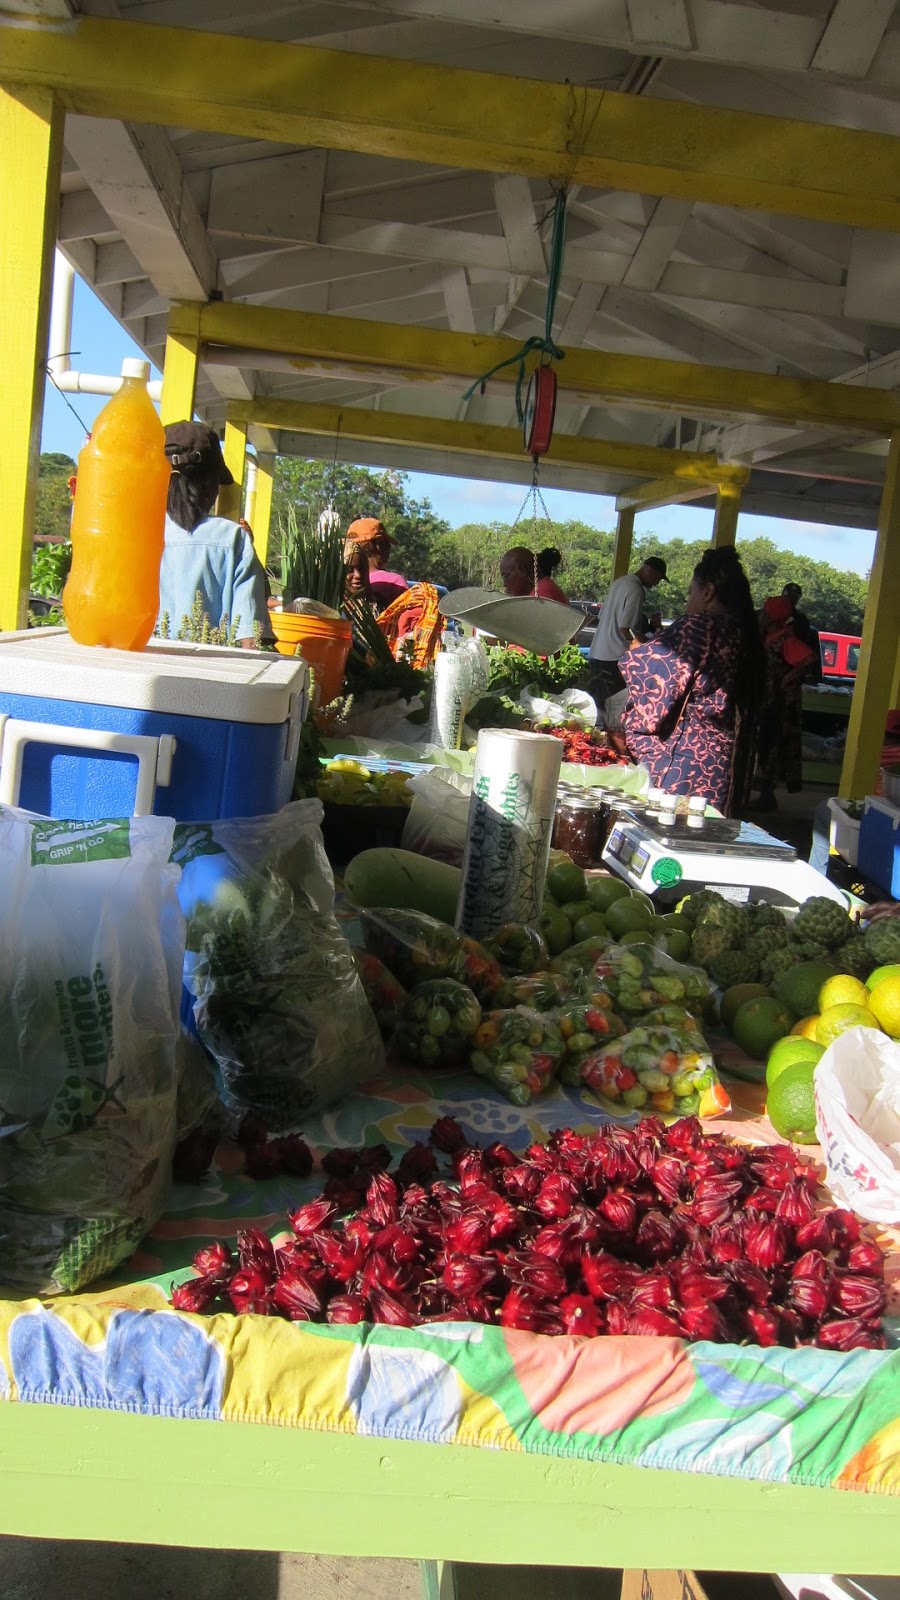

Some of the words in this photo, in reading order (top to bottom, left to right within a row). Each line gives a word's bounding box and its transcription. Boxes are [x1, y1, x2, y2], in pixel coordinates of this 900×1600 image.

[50, 846, 74, 859] GRIP
[76, 842, 87, 851] 'N
[88, 837, 104, 847] GO
[490, 772, 519, 873] Vegetables
[67, 976, 107, 1066] more
[65, 1036, 79, 1069] fruits
